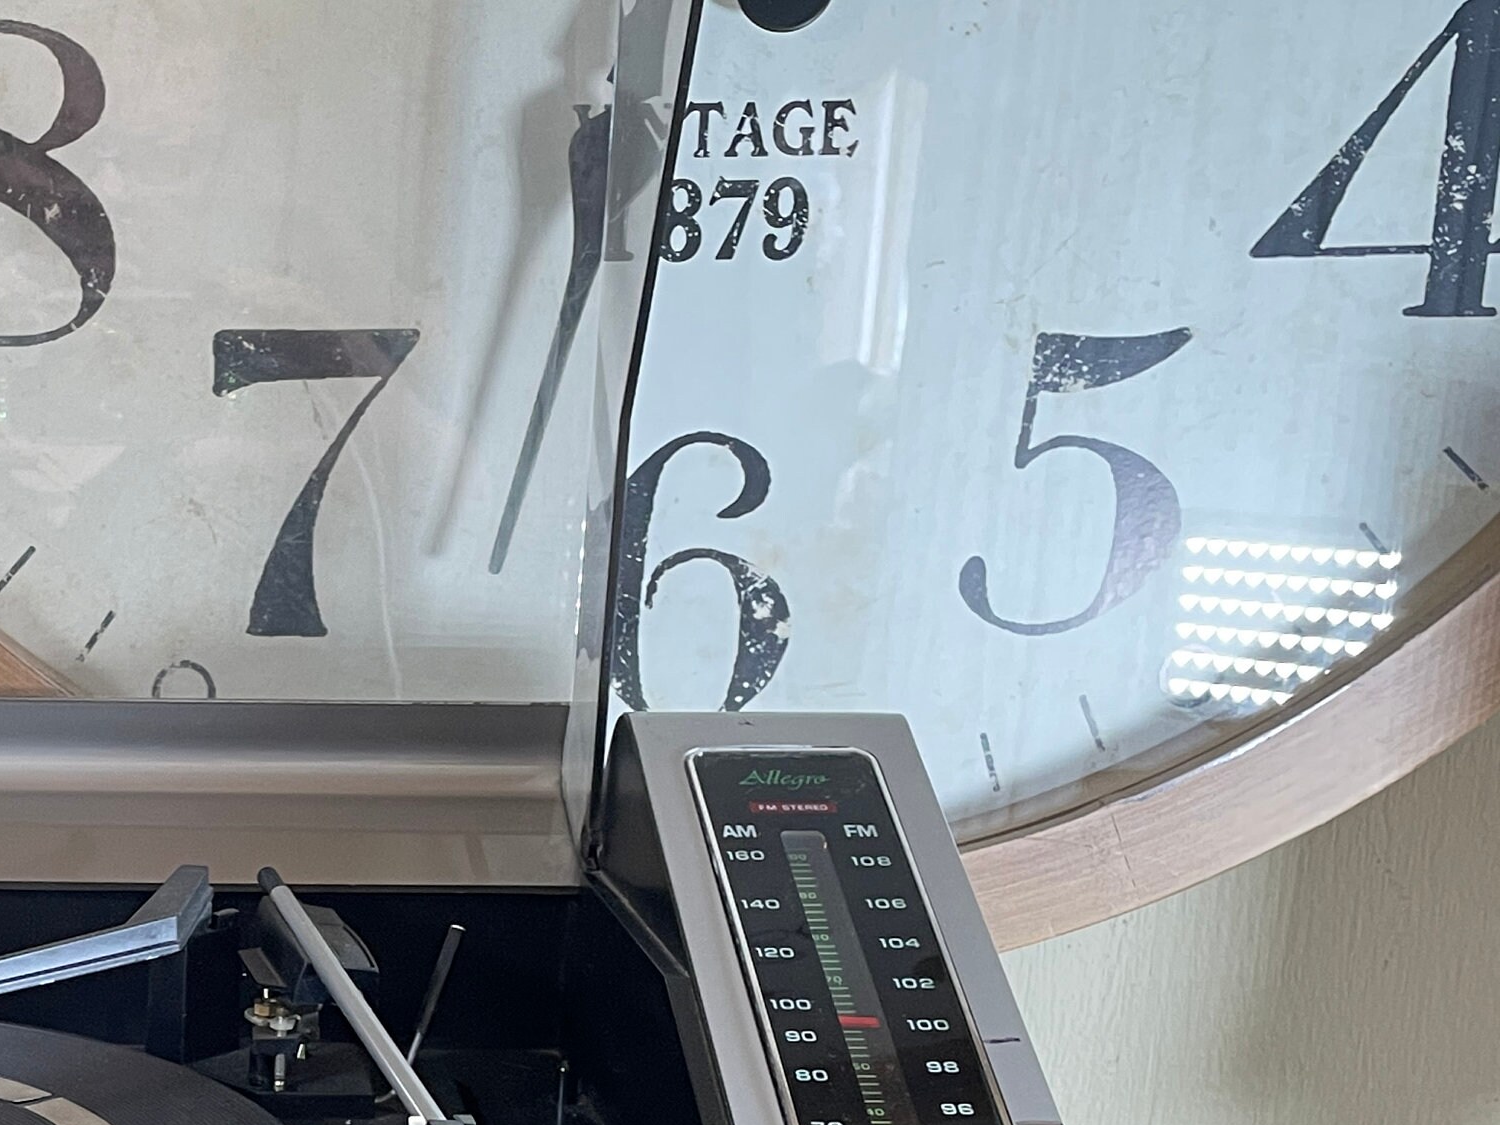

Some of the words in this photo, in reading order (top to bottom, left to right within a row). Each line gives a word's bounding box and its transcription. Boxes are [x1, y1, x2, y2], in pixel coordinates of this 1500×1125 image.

[683, 99, 860, 158] TAGE
[1250, 0, 1500, 317] 4
[213, 329, 420, 637] 7
[958, 327, 1192, 636] 5
[609, 431, 791, 712] 6
[739, 769, 830, 790] Allegro
[722, 825, 757, 838] AM
[844, 825, 878, 838] FM
[726, 850, 765, 862] 160
[851, 856, 891, 867] 108
[741, 898, 780, 910] 140
[865, 898, 907, 910] 106
[879, 937, 920, 949] 104
[755, 947, 794, 959] 120
[892, 977, 935, 989] 102
[769, 999, 812, 1011] 100
[906, 1019, 950, 1031] 100
[785, 1030, 817, 1042] 90
[926, 1061, 959, 1073] 98
[795, 1070, 828, 1082] 80
[941, 1104, 974, 1115] 96
